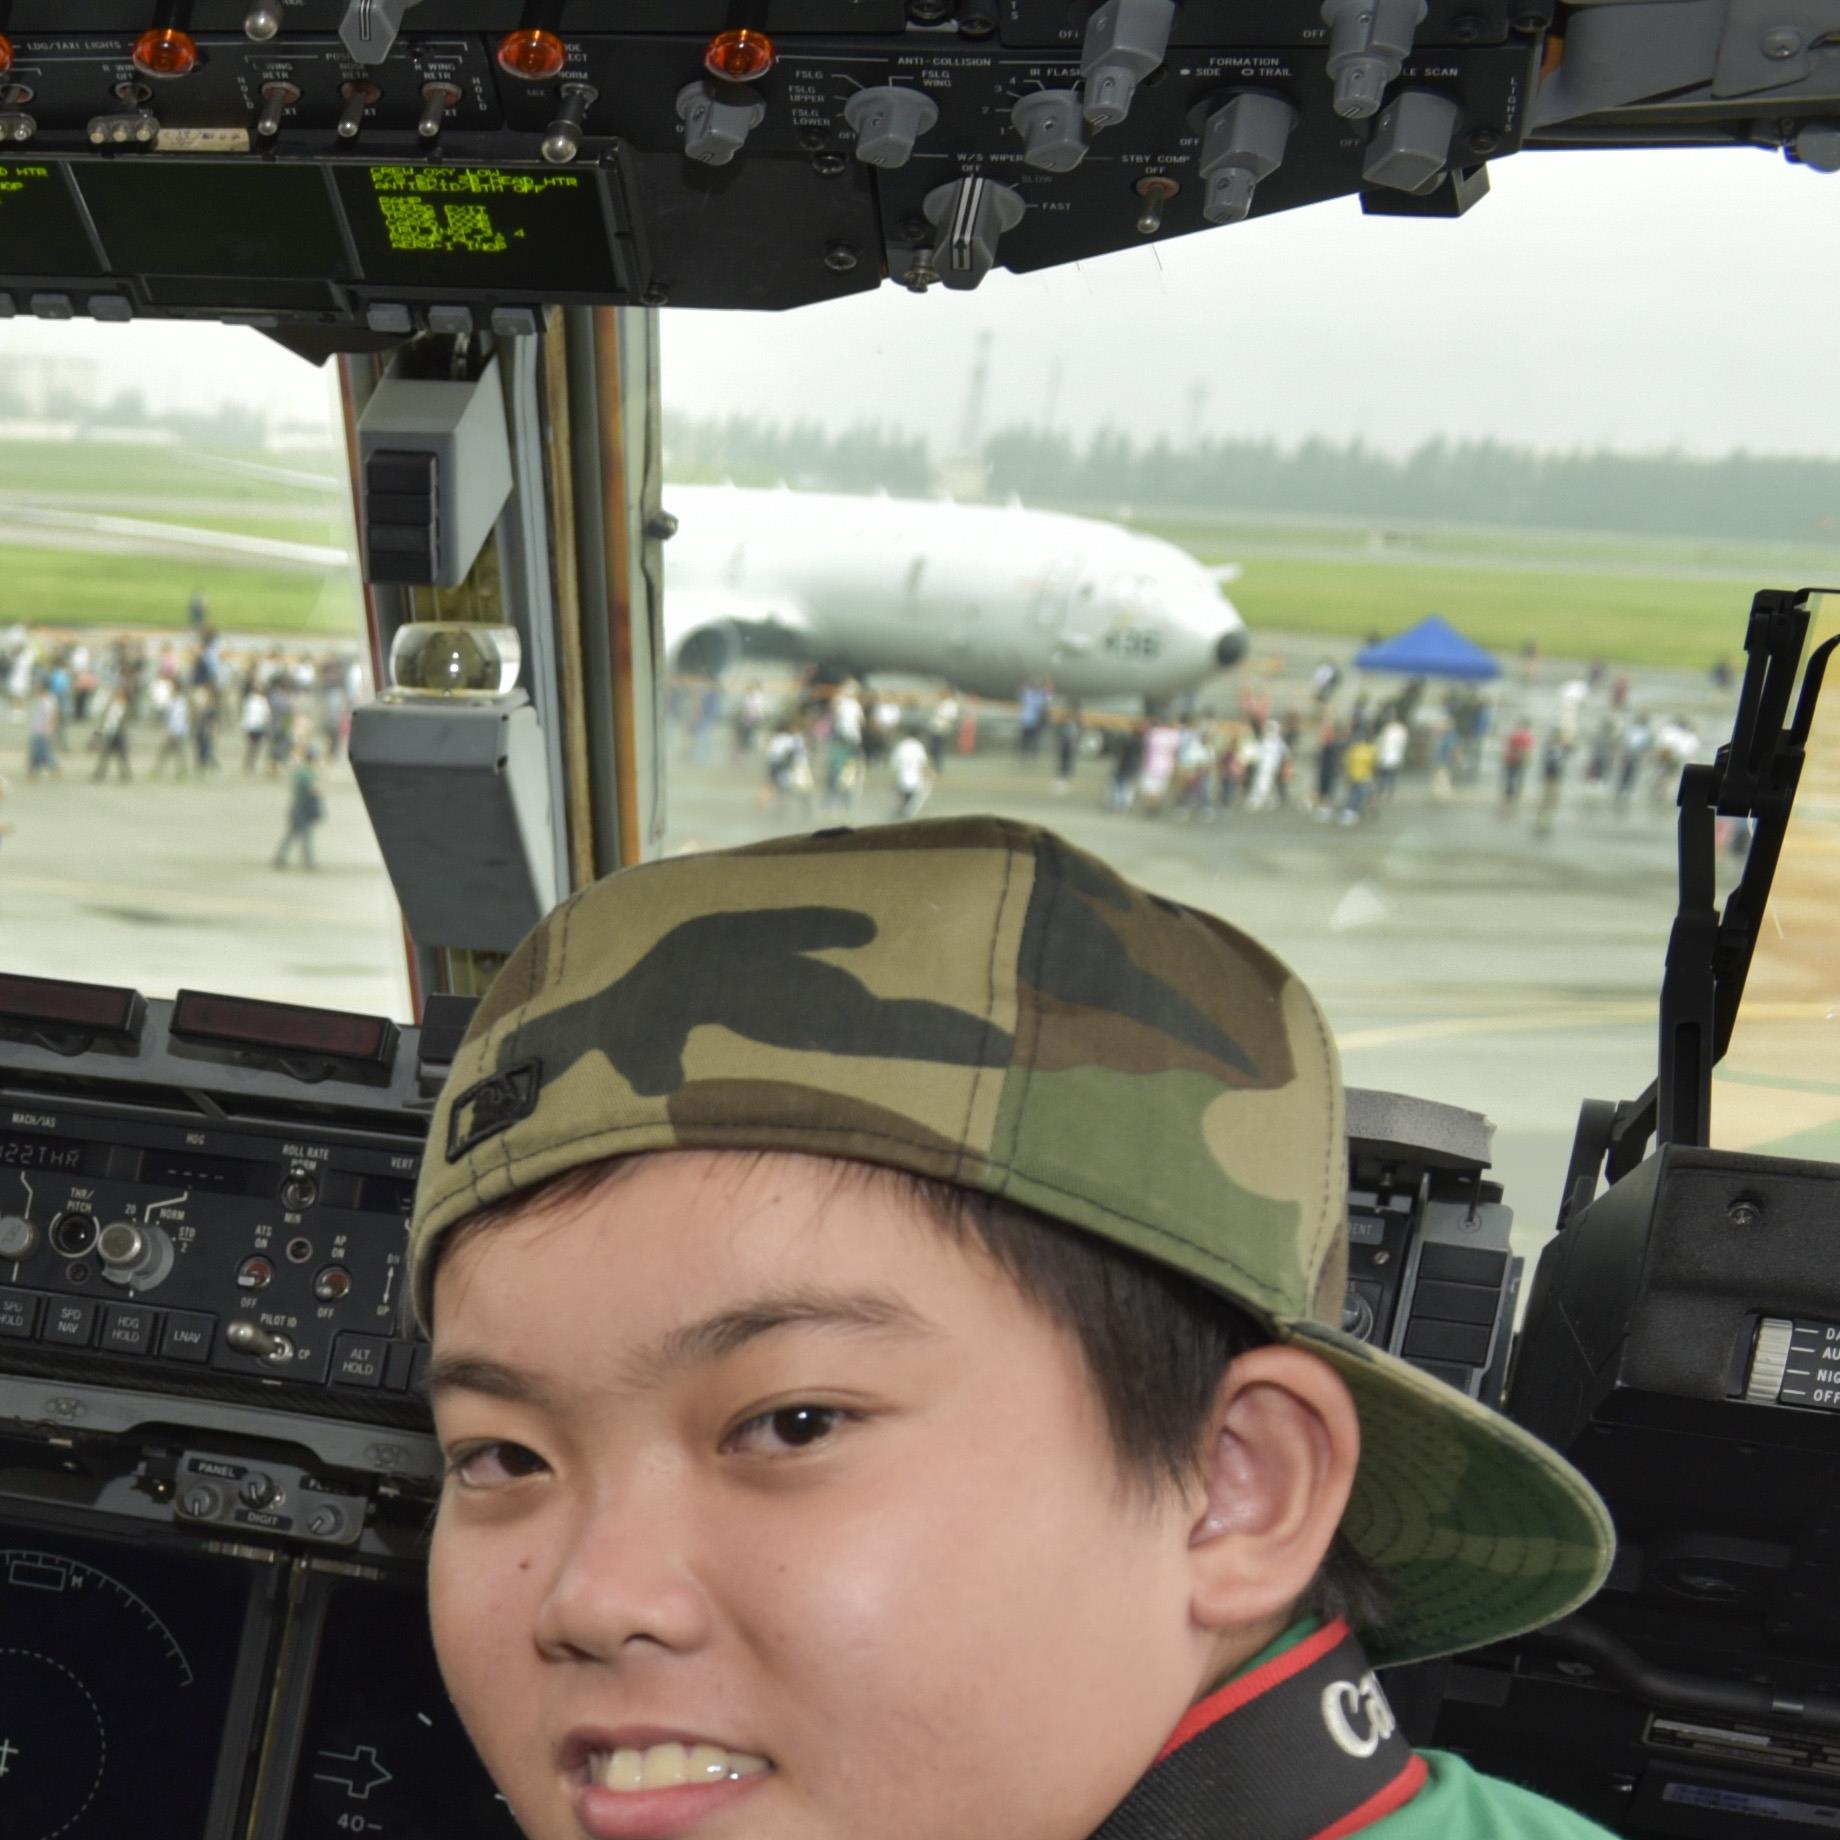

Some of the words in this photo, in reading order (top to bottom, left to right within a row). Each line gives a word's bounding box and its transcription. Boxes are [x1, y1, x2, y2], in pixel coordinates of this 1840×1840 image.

[85, 41, 121, 50] LIGHTS
[896, 57, 992, 67] ANTI-COLLISION
[1208, 57, 1280, 67] FORMATION
[795, 71, 824, 80] FSLG
[921, 70, 951, 79] FSLG
[1196, 68, 1222, 77] SIDE
[1258, 68, 1293, 77] TRAIL
[1418, 67, 1459, 78] SCAN
[922, 79, 952, 88] WING
[792, 117, 831, 126] LOWER
[1180, 137, 1200, 147] OFF
[956, 153, 984, 162] W/S
[1121, 154, 1149, 164] STBY
[1156, 154, 1191, 164] COMP
[1145, 165, 1166, 175] OFF
[1042, 202, 1072, 212] FAST
[11, 1112, 56, 1128] MACH/IAS
[282, 1144, 305, 1157] ROLL
[306, 1147, 329, 1160] RATE
[390, 1157, 414, 1170] VERT
[66, 1200, 93, 1213] PITCH
[57, 1321, 78, 1334] NAV
[112, 1328, 140, 1343] HOLD
[174, 1329, 201, 1343] LNAV
[350, 1348, 371, 1361] ALT
[342, 1361, 374, 1377] HOLD
[197, 1462, 236, 1478] PANEL
[247, 1512, 279, 1526] DIGIT
